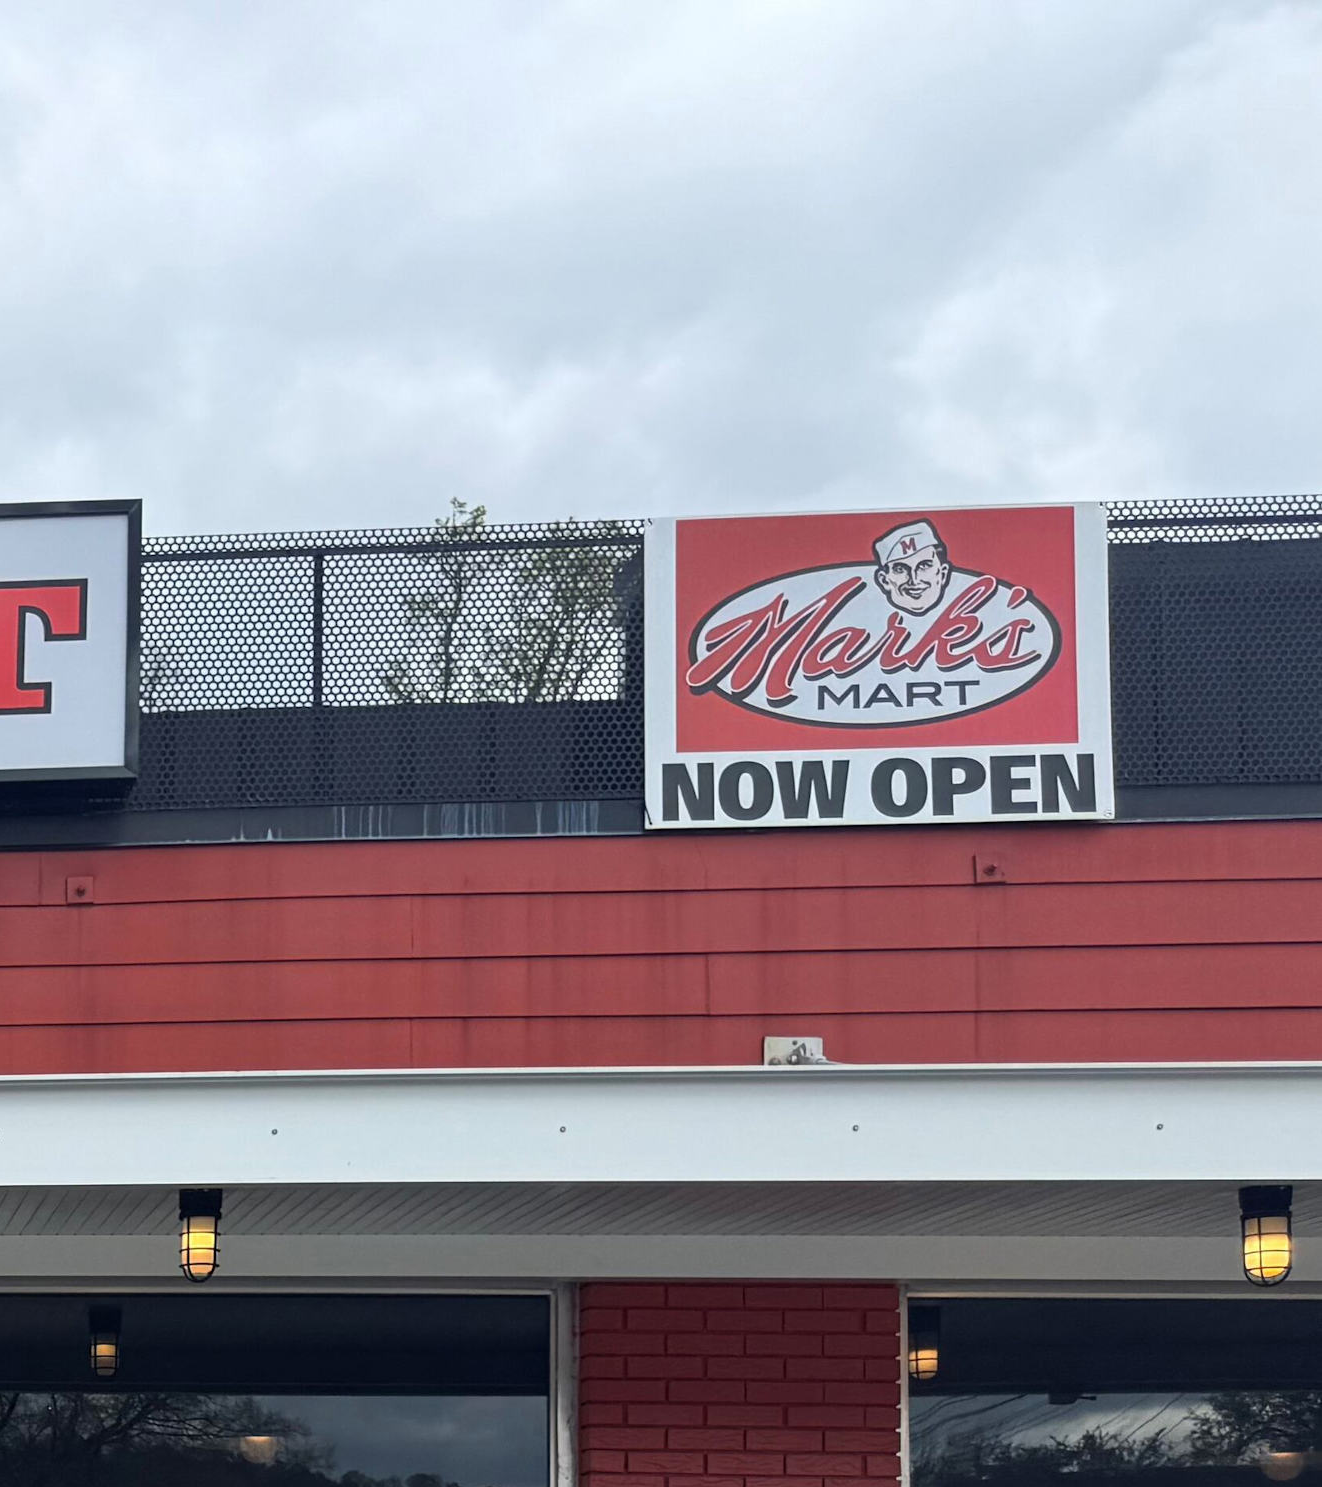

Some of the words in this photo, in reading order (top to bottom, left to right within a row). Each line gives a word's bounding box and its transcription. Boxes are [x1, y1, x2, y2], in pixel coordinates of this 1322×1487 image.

[685, 575, 1043, 706] Mark's
[817, 680, 980, 710] MART
[662, 759, 850, 822] NOW
[870, 753, 1097, 816] OPEN
